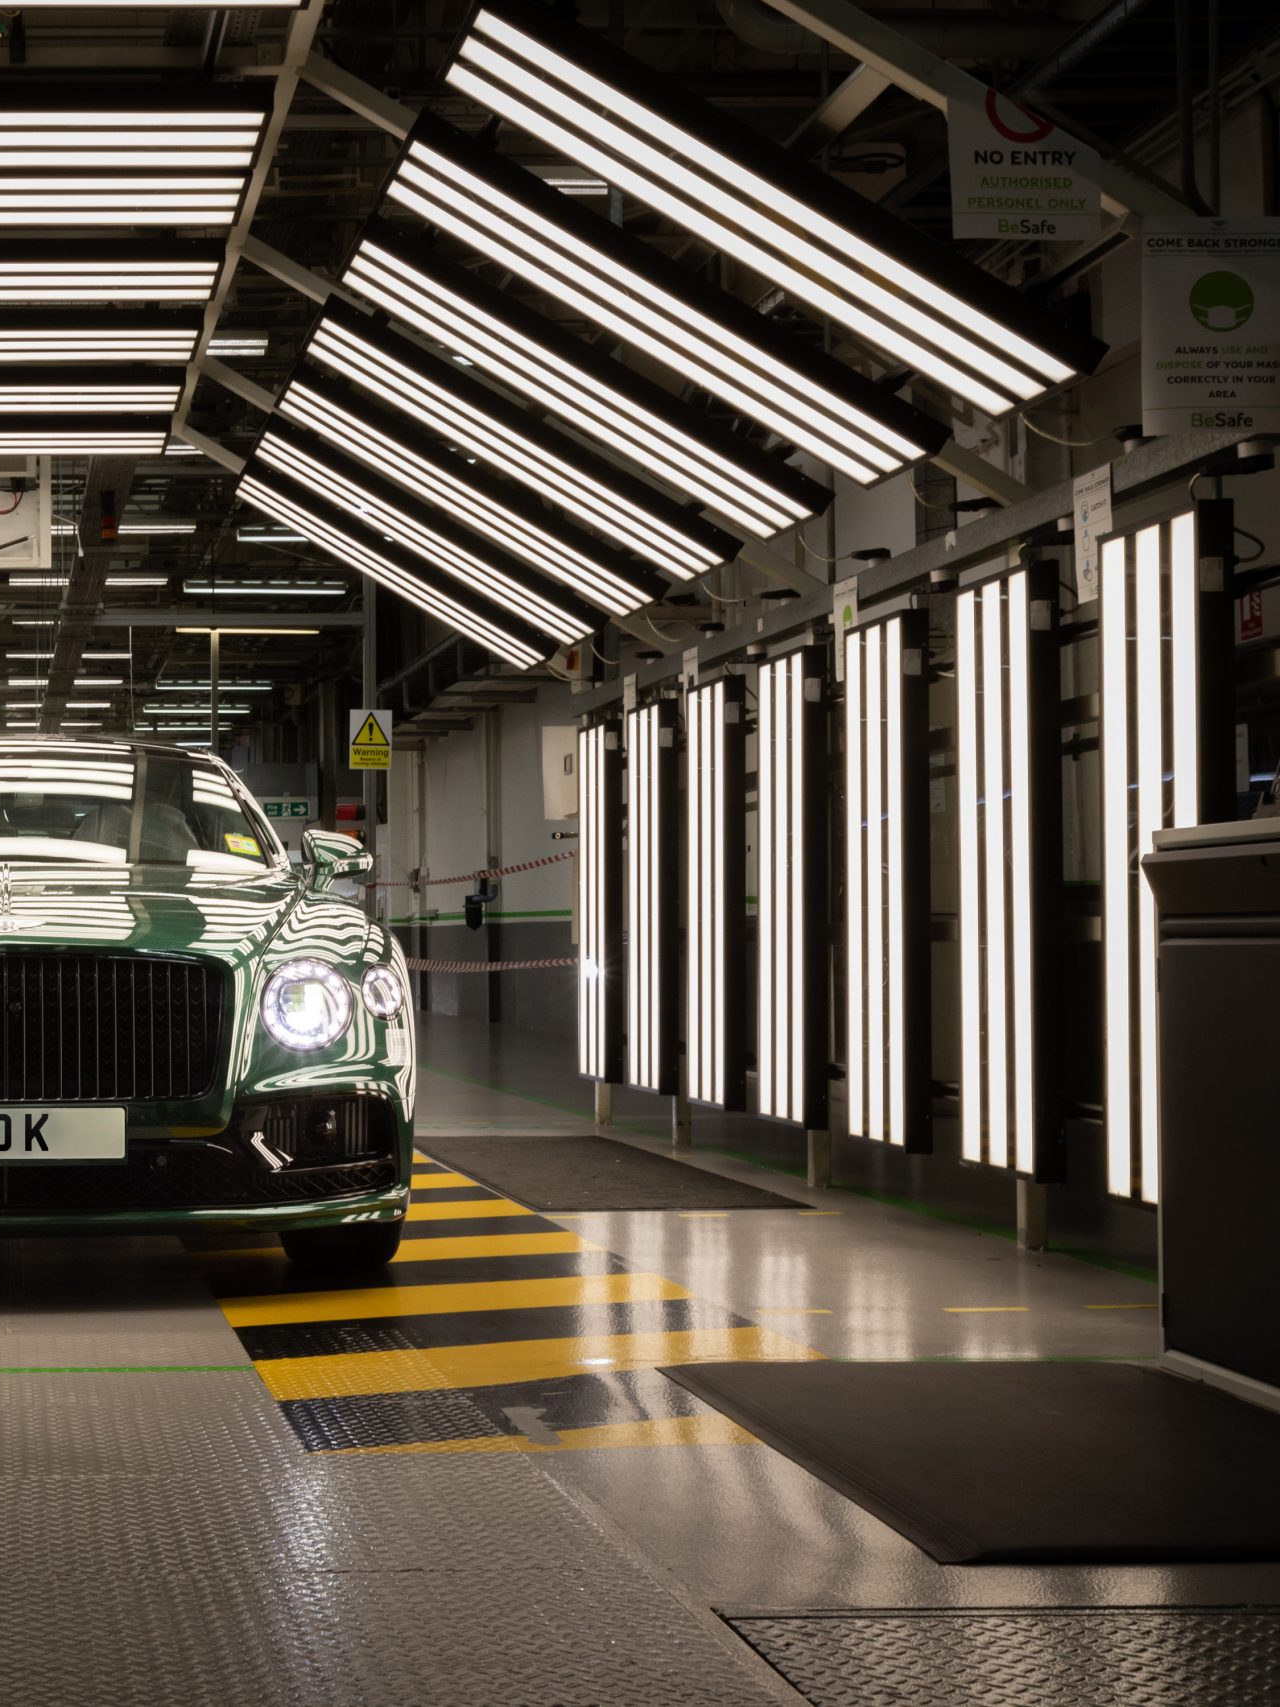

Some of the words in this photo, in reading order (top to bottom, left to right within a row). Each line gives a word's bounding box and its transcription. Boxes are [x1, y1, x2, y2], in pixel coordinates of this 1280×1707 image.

[974, 150, 1004, 164] NO
[1011, 151, 1077, 165] ENTRY
[980, 176, 1073, 188] AUTHORISED
[968, 197, 1042, 209] PERSONEL
[1048, 198, 1088, 209] ONLY
[998, 219, 1056, 234] BeSafe
[1147, 238, 1183, 247] COME
[1187, 238, 1220, 248] BACK
[1175, 346, 1218, 354] ALWAYS
[1221, 346, 1242, 354] USE
[1245, 346, 1268, 354] AND
[1156, 361, 1203, 370] DISPOSE
[1206, 361, 1221, 369] OF
[1224, 361, 1253, 369] YOUR
[1167, 376, 1229, 384] CORRECTLY
[1232, 376, 1243, 384] IN
[1247, 376, 1276, 384] YOUR
[1208, 390, 1237, 399] AREA
[1191, 413, 1253, 428] BeSafe
[353, 747, 389, 758] Warning
[24, 1113, 49, 1152] K
